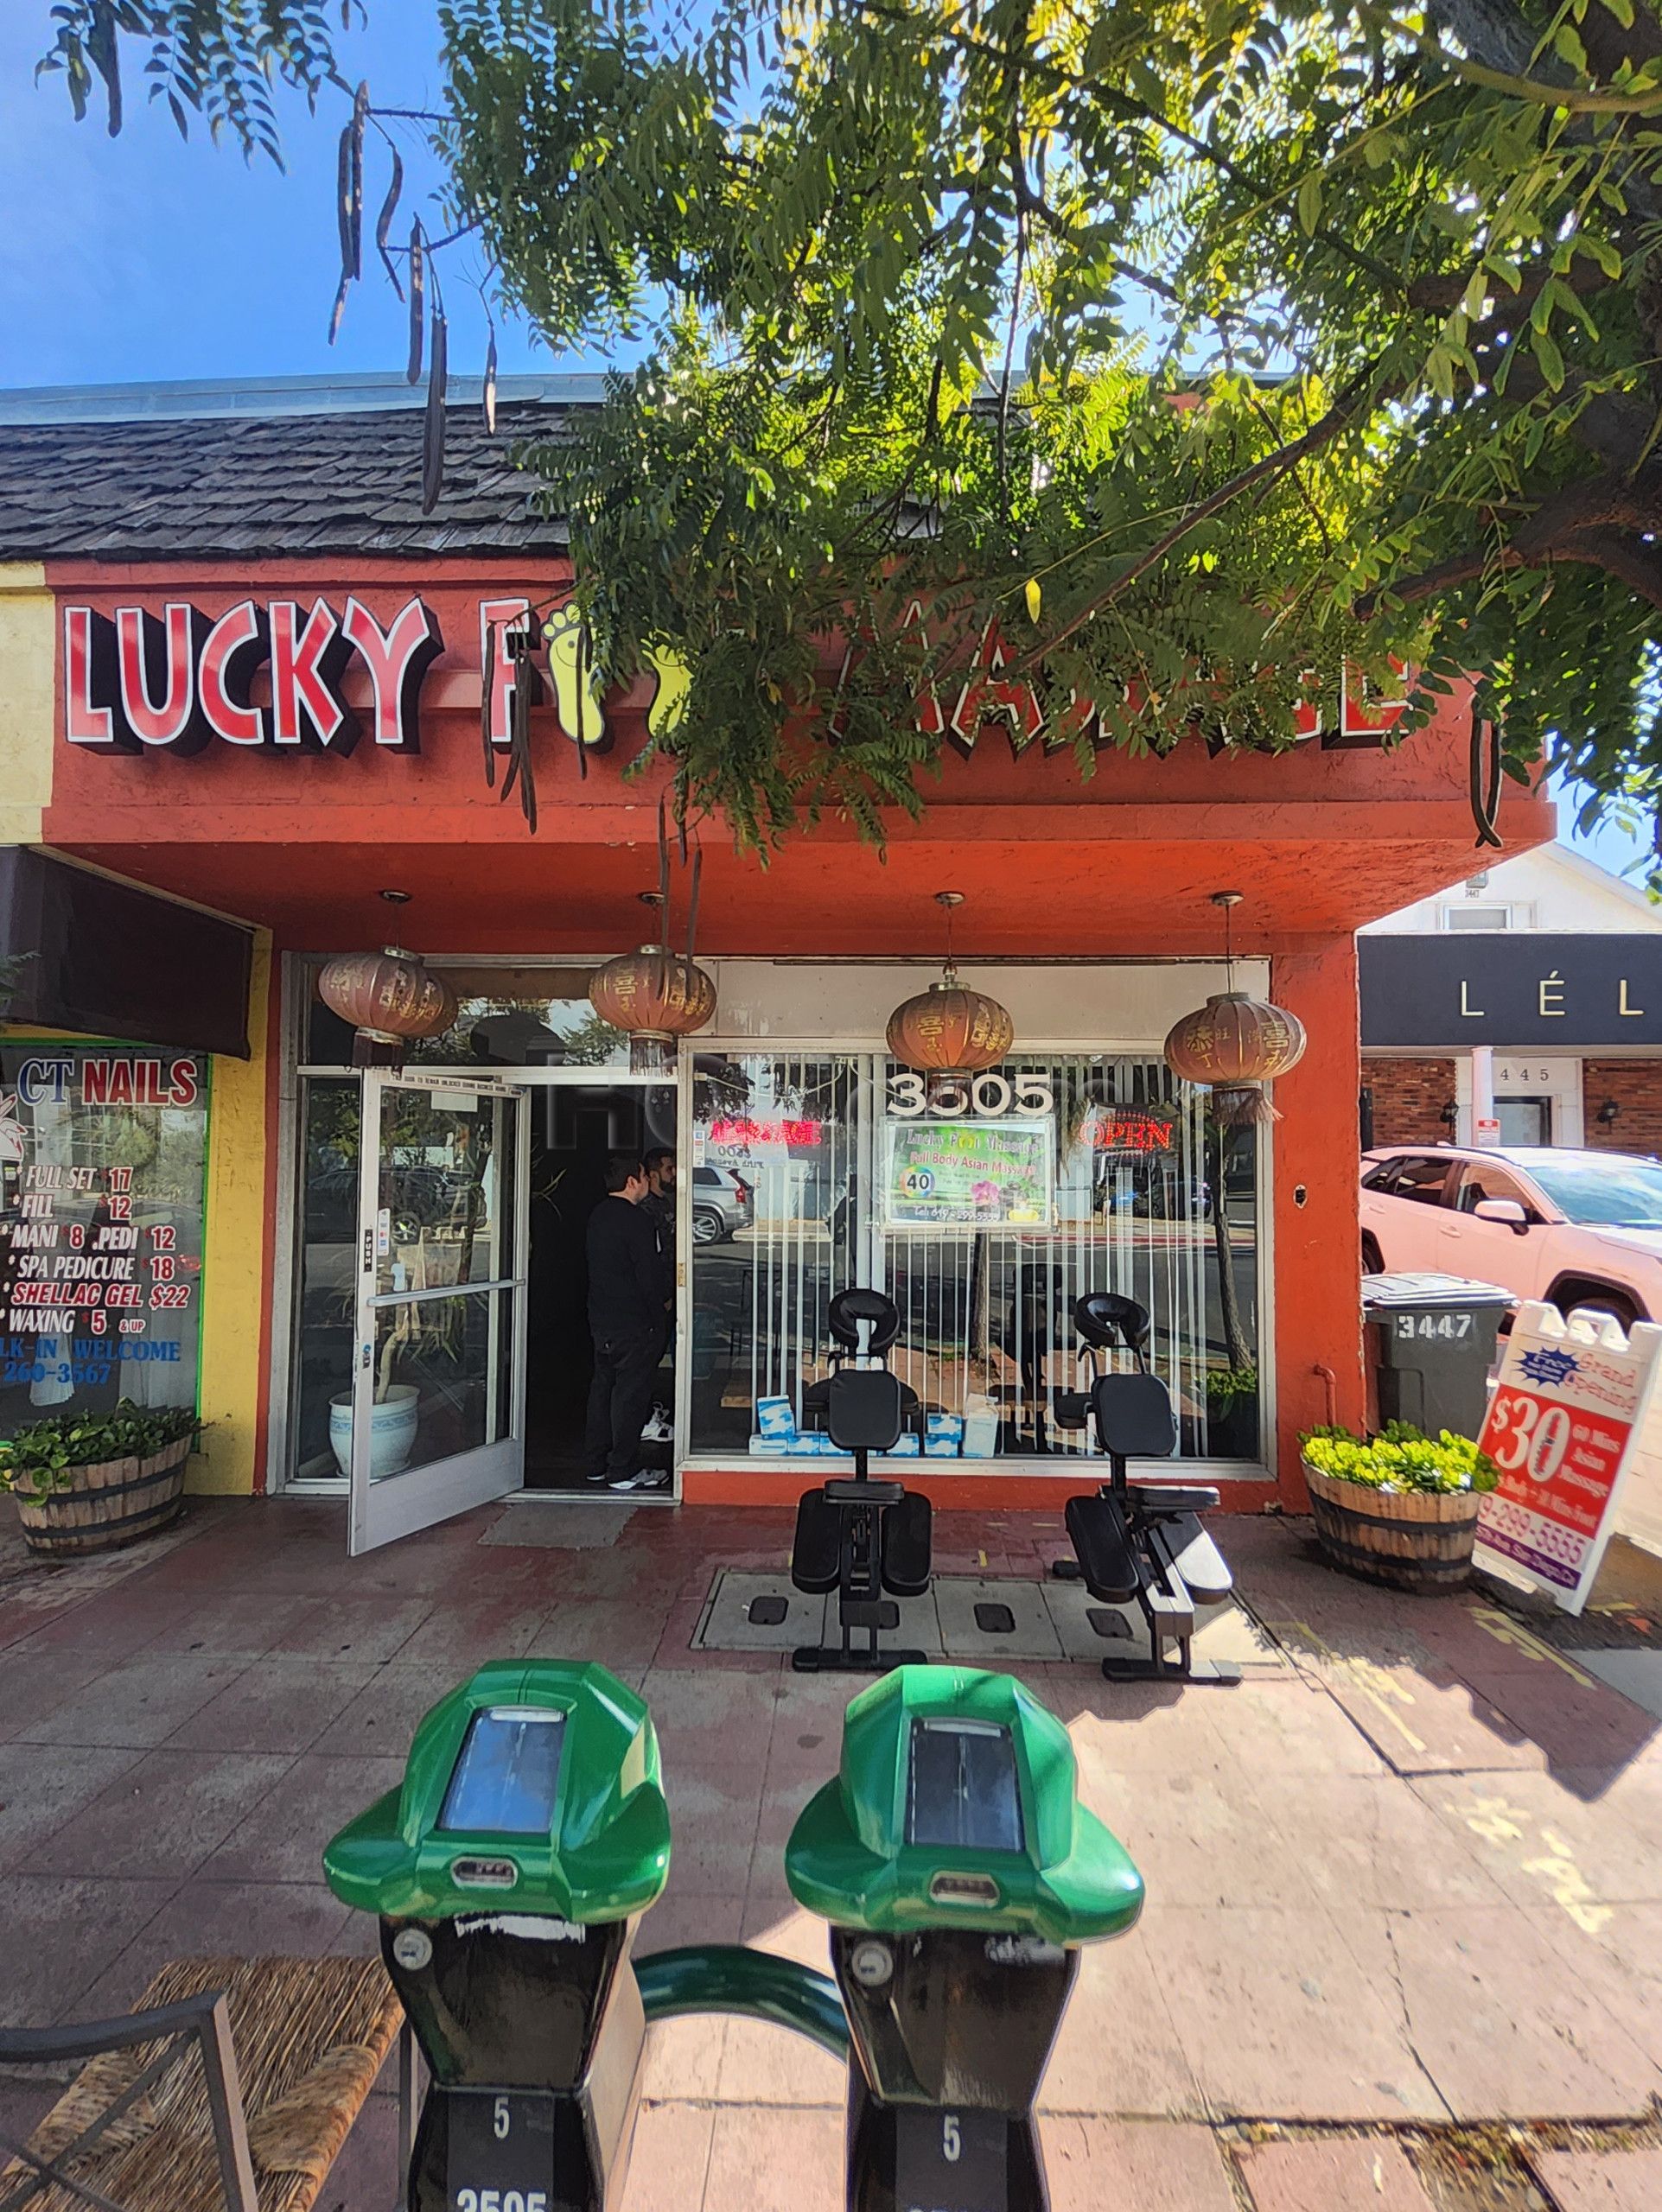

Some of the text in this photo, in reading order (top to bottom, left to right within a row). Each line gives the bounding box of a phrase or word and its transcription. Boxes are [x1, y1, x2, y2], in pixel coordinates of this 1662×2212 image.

[64, 596, 431, 746] LUCKY
[18, 1058, 198, 1107] CT NAILS
[907, 1128, 944, 1149] Lucky
[1079, 1121, 1173, 1149] OPEN
[910, 1151, 929, 1164] Full
[933, 1152, 958, 1167] Body
[961, 1156, 989, 1172] Asian
[991, 1161, 1036, 1178] Massage
[25, 1166, 63, 1190] FULL
[67, 1166, 98, 1190] SET
[907, 1173, 930, 1190] 40
[21, 1193, 54, 1218] FILL
[10, 1224, 59, 1249] MANI
[16, 1255, 48, 1279] SPA
[53, 1255, 136, 1281] PEDICURE
[11, 1282, 191, 1311] SHELLAC GEL $22
[9, 1309, 76, 1333] WAXING
[118, 1321, 128, 1333] &
[130, 1319, 146, 1333] UP
[1398, 1314, 1472, 1338] 3447
[73, 1339, 181, 1362] WELCOME
[1491, 1395, 1570, 1484] $30
[494, 2096, 510, 2139] 5
[943, 2114, 961, 2161] 5
